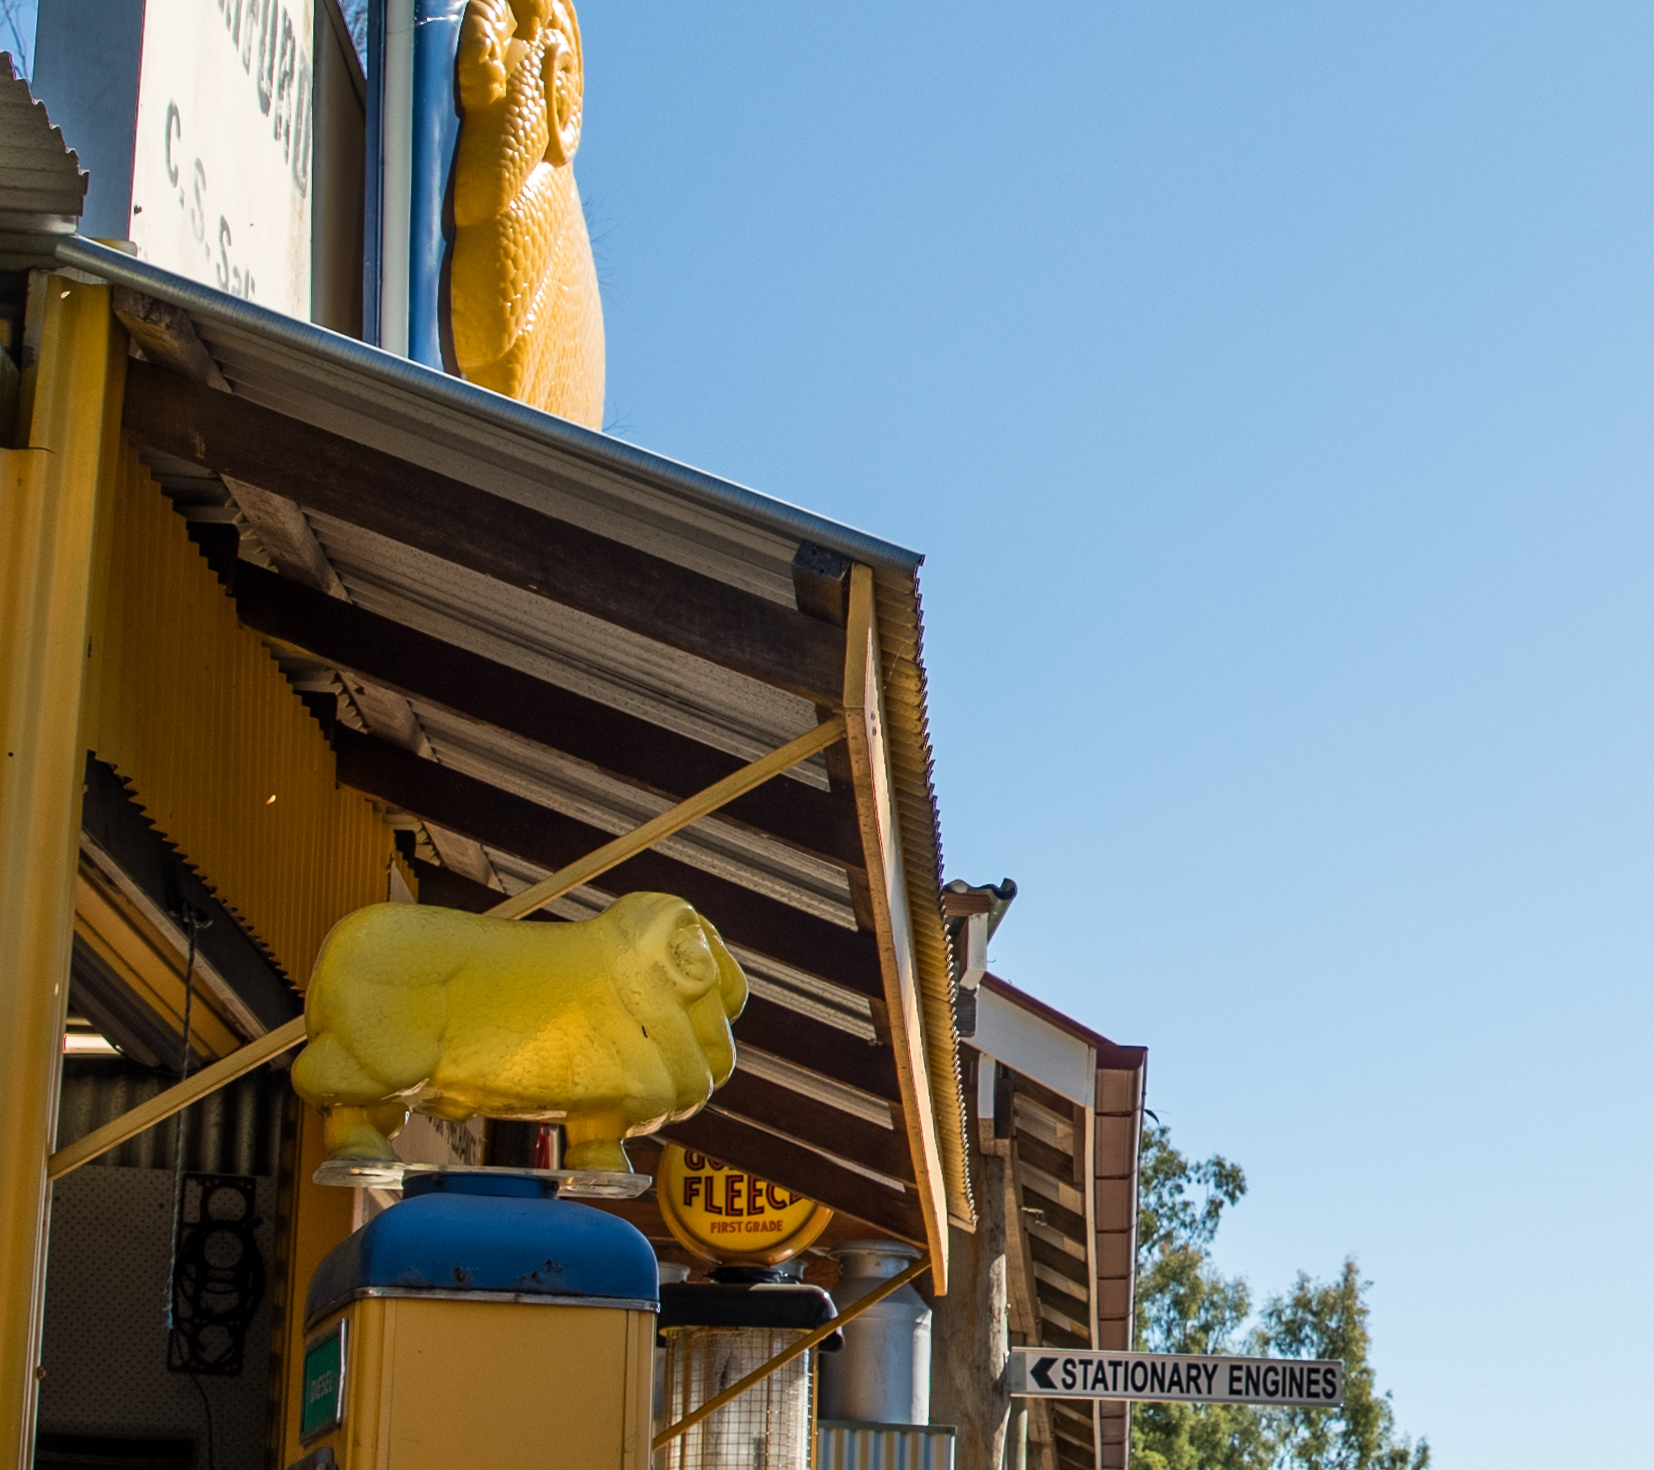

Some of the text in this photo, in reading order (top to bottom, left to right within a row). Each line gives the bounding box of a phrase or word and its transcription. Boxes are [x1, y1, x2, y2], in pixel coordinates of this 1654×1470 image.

[710, 1220, 783, 1234] FIRST GRADE
[1060, 1357, 1338, 1400] STATIONARY ENGINES
